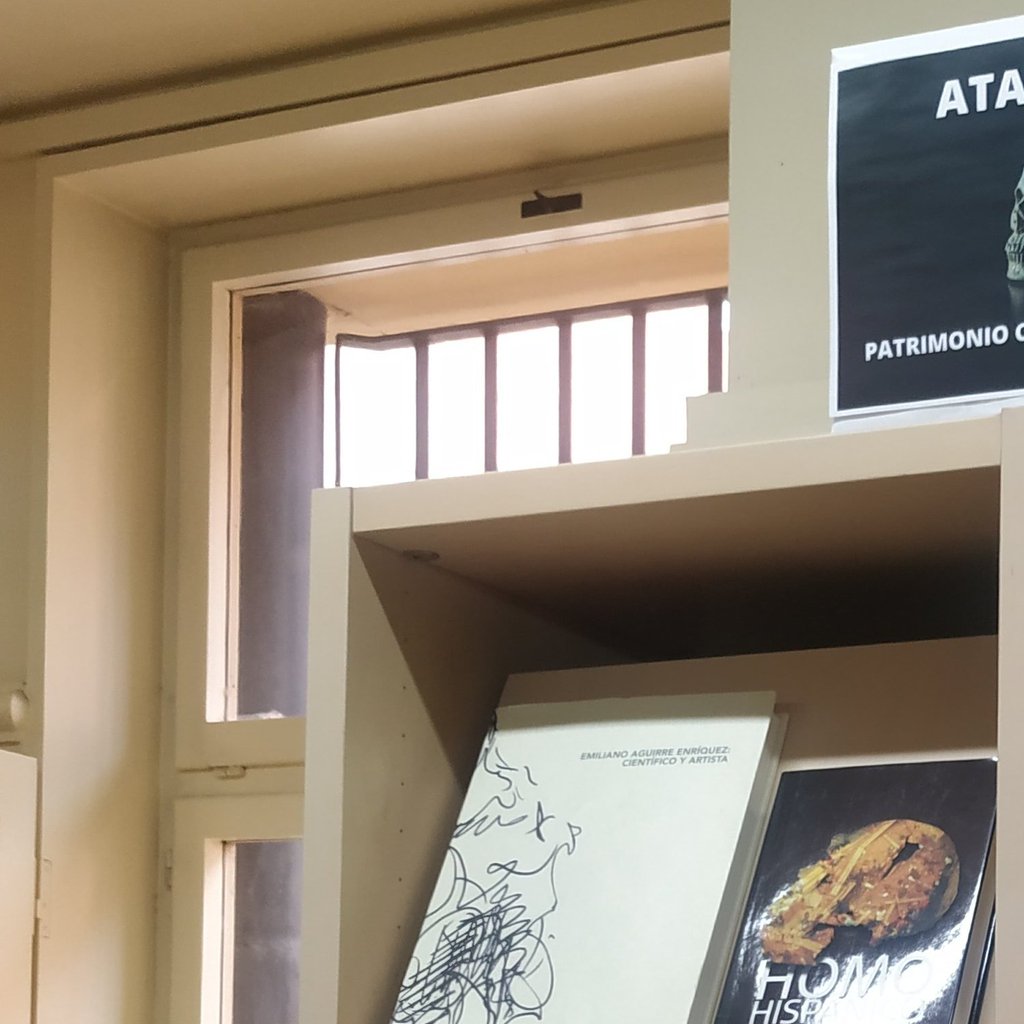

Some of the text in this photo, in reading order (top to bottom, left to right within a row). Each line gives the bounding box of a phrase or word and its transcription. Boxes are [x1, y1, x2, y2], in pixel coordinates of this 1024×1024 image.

[864, 325, 1008, 361] PATRIMONIO
[580, 750, 628, 760] EMILIANO
[631, 748, 674, 758] AGUIRRE
[622, 756, 677, 767] CIENTÍFICO
[688, 755, 728, 764] ARTISTA
[756, 953, 932, 1001] HOMO
